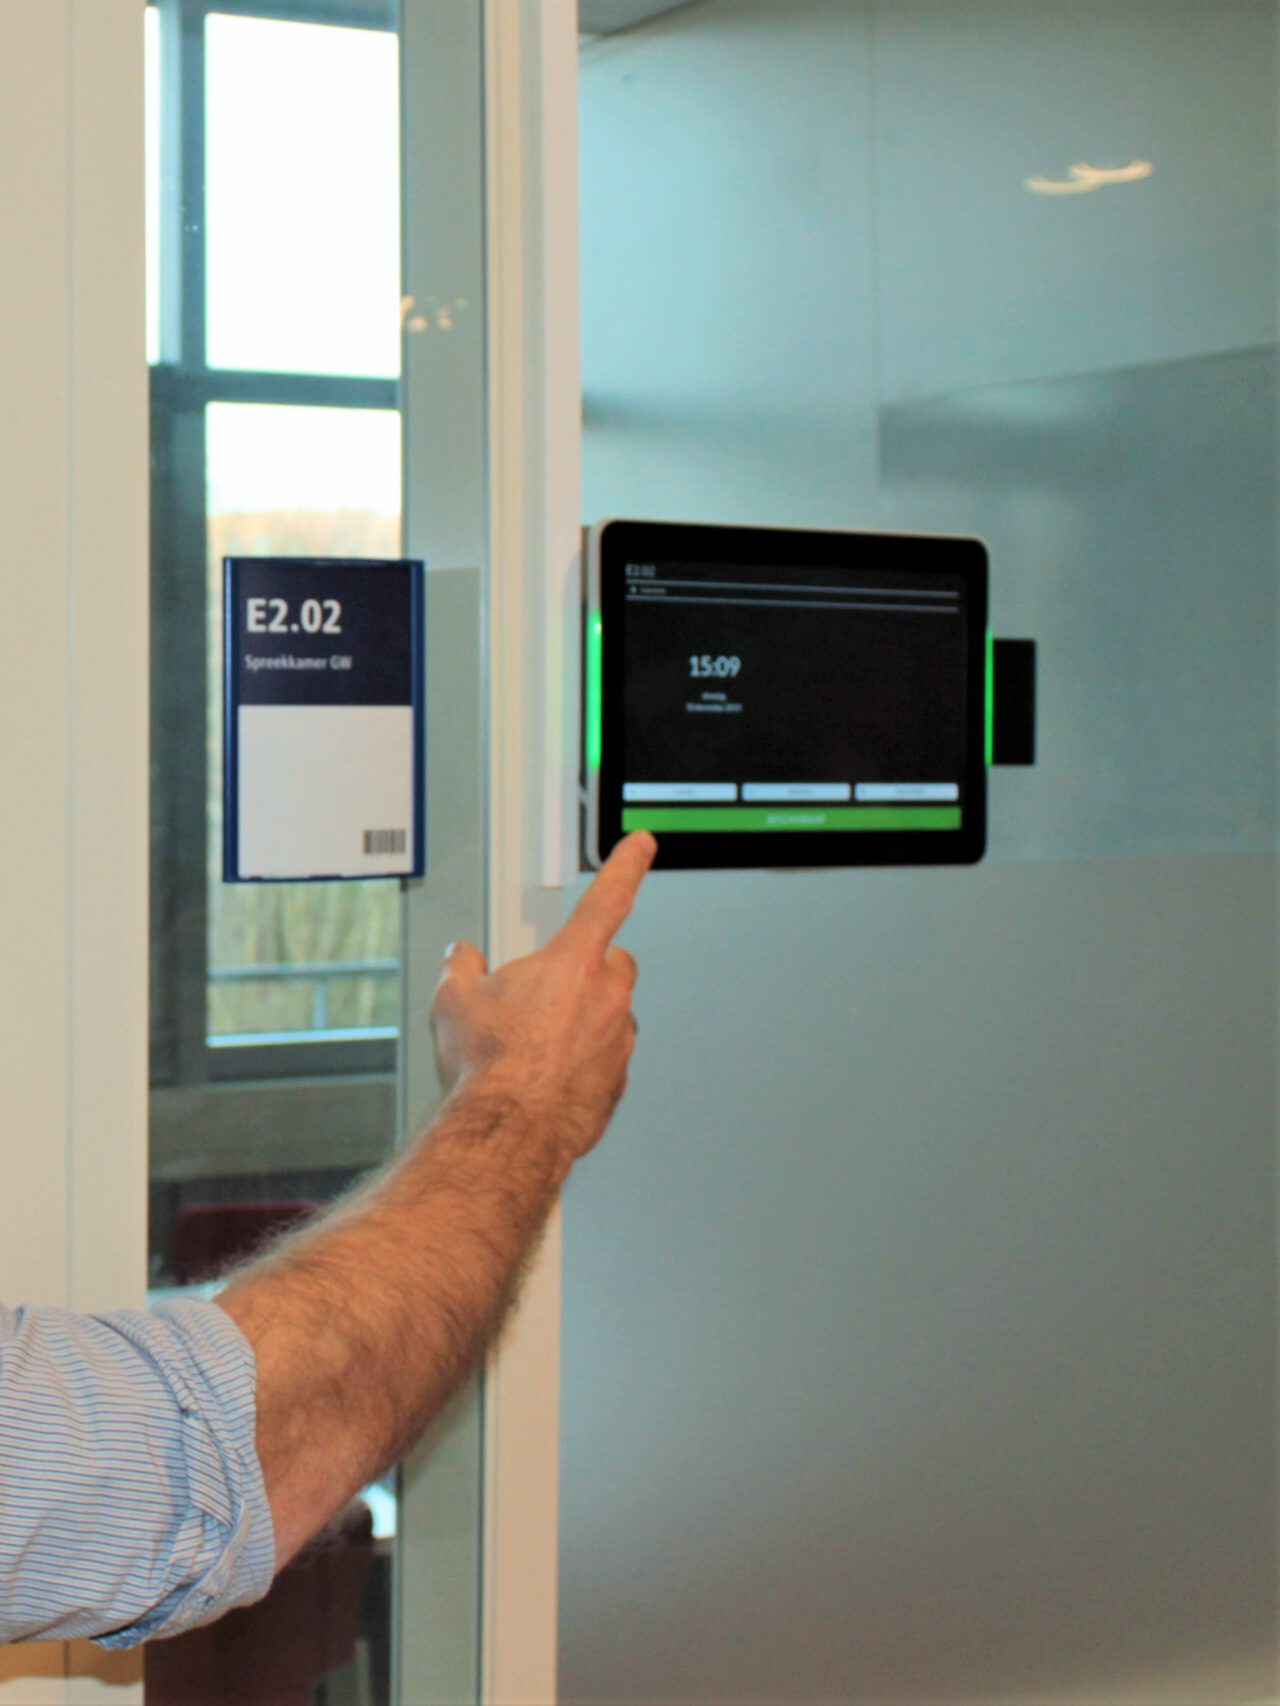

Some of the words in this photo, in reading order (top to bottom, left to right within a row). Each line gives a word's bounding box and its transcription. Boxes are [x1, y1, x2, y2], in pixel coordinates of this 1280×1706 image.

[246, 597, 342, 634] E2.02
[244, 653, 327, 672] Spreekkamer
[688, 654, 742, 678] 15:09
